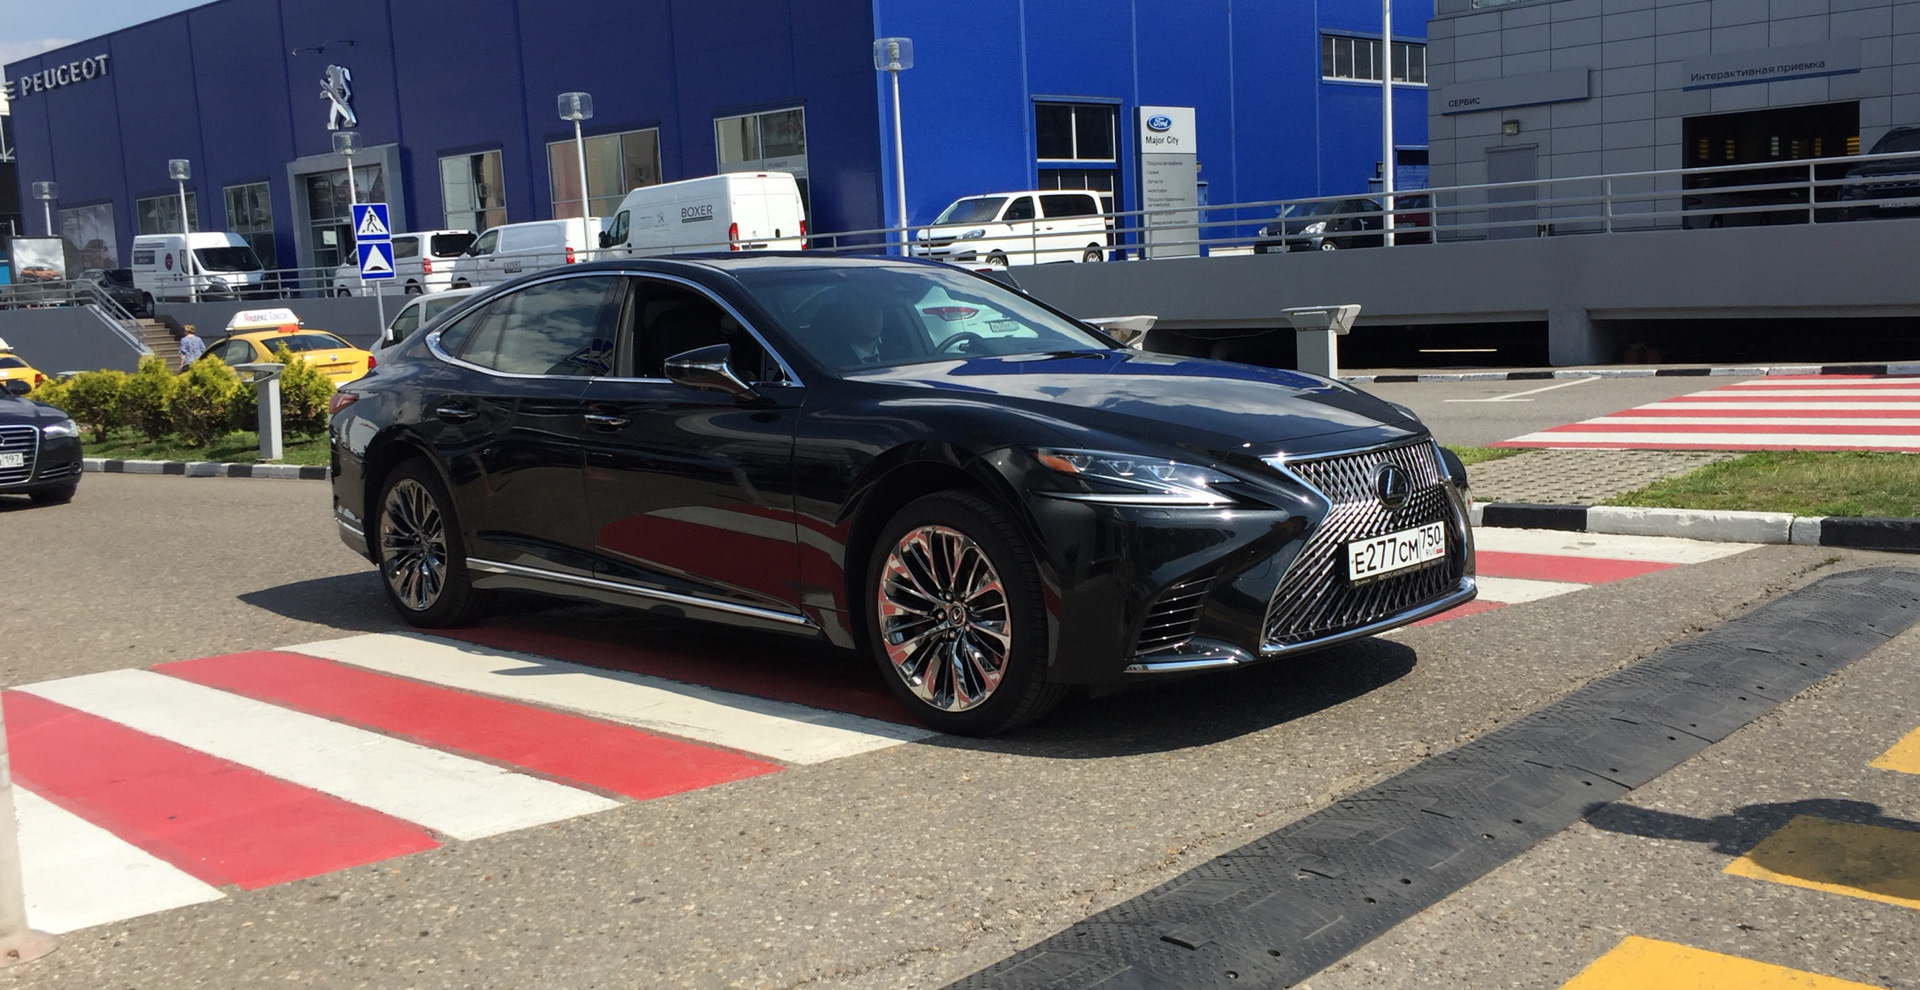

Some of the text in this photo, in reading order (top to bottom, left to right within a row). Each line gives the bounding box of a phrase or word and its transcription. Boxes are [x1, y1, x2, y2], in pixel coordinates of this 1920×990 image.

[20, 53, 109, 96] PEUGEOT
[1690, 60, 1826, 82] Интерактивная приемка
[1448, 97, 1481, 107] СЕРВИС
[1145, 136, 1179, 146] Major City
[681, 204, 713, 218] BOXER
[4, 455, 20, 463] 197
[1419, 524, 1441, 549] 750
